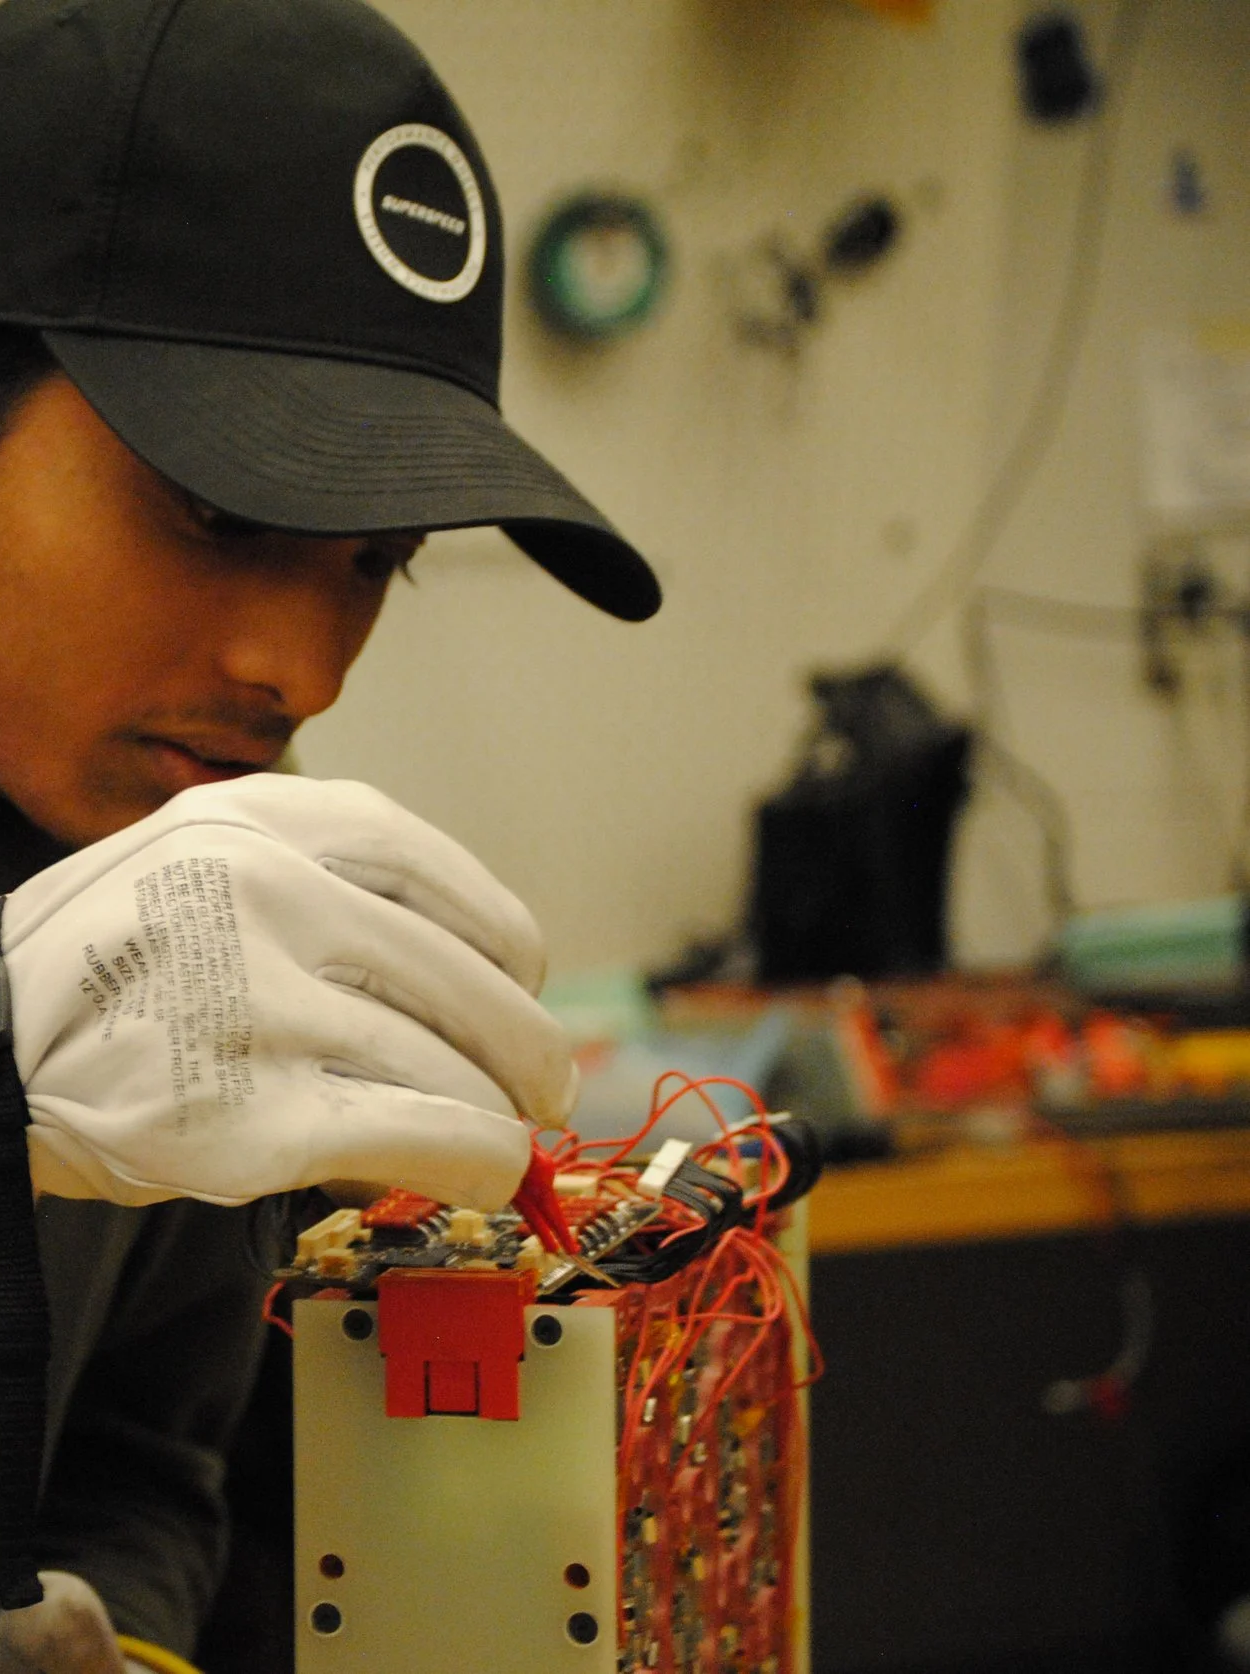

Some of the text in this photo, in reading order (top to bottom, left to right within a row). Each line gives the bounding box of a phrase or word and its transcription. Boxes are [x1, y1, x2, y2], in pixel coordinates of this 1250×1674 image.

[172, 860, 186, 880] NOT
[190, 858, 206, 902] RUBBER
[201, 858, 216, 886] ONLY
[176, 884, 190, 896] BE
[208, 888, 222, 912] FOR
[197, 906, 214, 954] GLOVES
[124, 938, 150, 980] WEAR
[190, 936, 202, 960] FOR
[82, 944, 121, 996] RUBBER
[112, 956, 136, 984] SIZE
[161, 865, 184, 933] PROTECTION
[188, 1060, 202, 1084] THE
[207, 956, 219, 981] AND
[214, 858, 232, 910] LEATHER
[240, 1062, 256, 1095] USED
[214, 1041, 225, 1066] AND
[215, 1069, 228, 1108] SHALL
[230, 1080, 244, 1106] FOR
